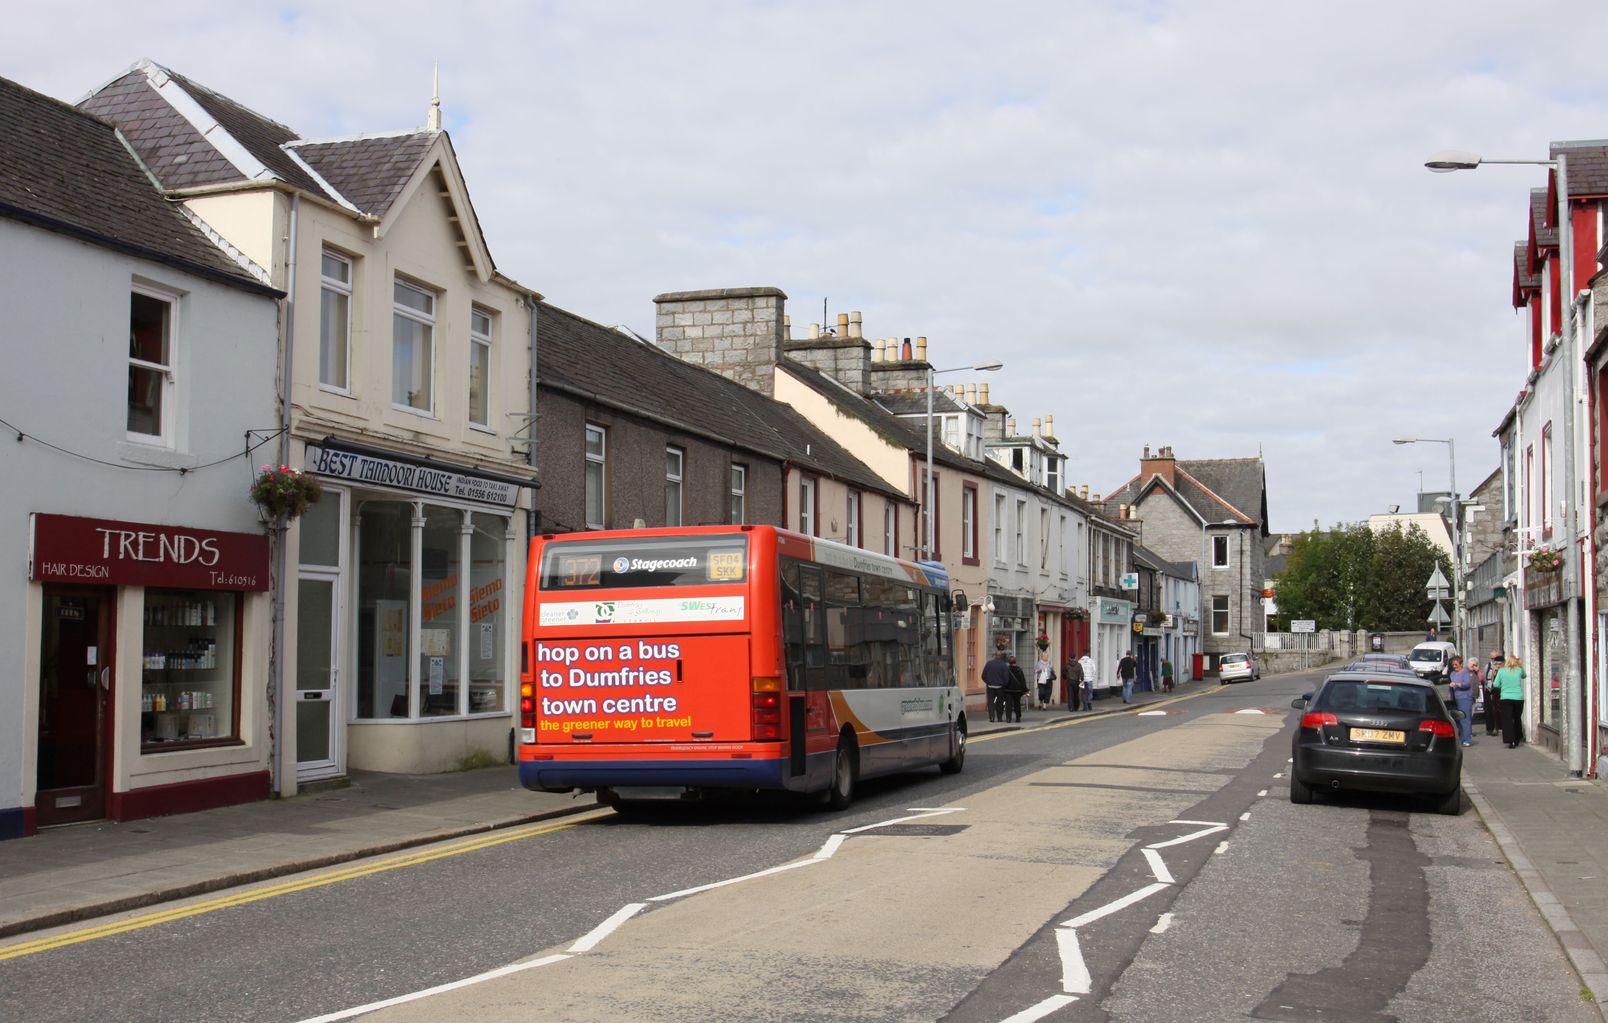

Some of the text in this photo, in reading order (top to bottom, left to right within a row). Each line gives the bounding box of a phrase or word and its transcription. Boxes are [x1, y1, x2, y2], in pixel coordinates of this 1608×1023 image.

[317, 450, 452, 493] BEST TANDOORI HOUSE
[456, 476, 509, 492] INDIAN FOOD TO TAKE AWAY
[455, 485, 507, 503] Tel. 01556 612100
[96, 528, 219, 566] TRENDS
[630, 556, 697, 572] Stagecoach
[712, 555, 740, 564] SF04
[42, 562, 109, 578] HAIR DESIGN
[564, 558, 600, 585] 372
[716, 566, 736, 576] SKK
[537, 640, 680, 666] hop on a bus
[540, 666, 672, 687] to Dumfries
[542, 693, 677, 715] town centre
[540, 715, 691, 733] the greener way to travel
